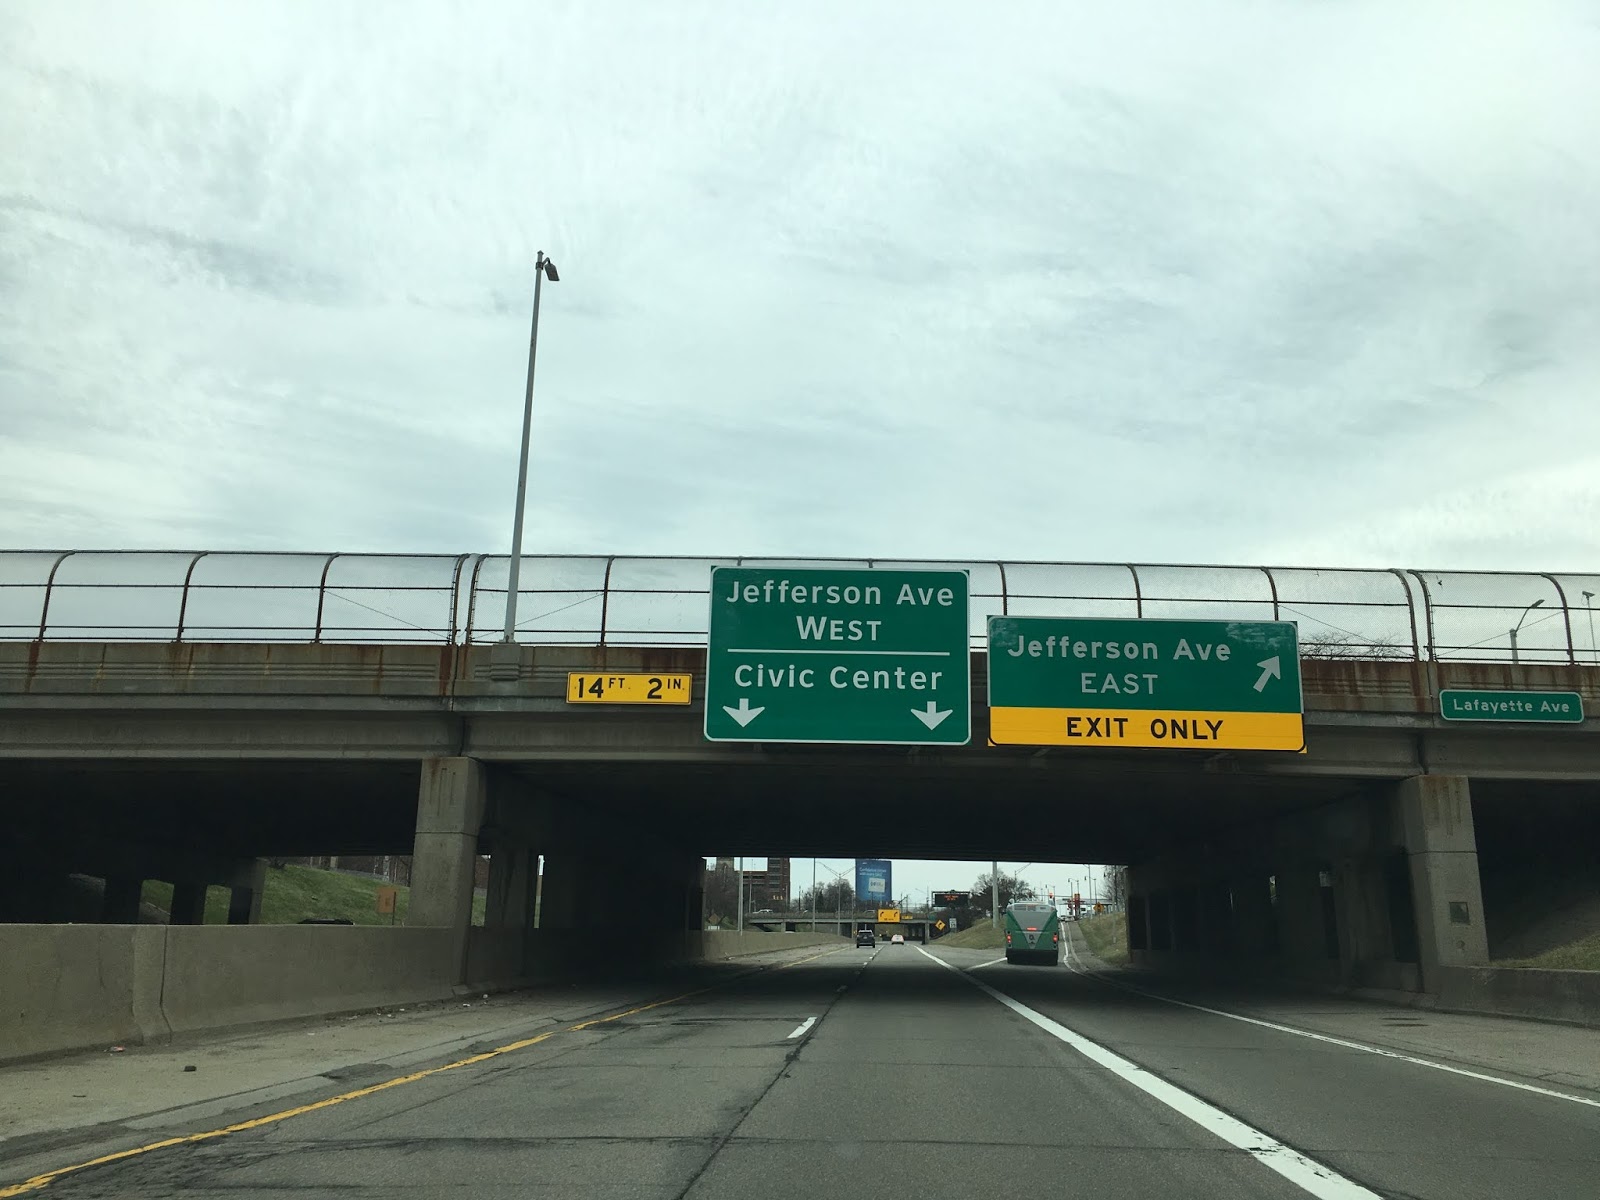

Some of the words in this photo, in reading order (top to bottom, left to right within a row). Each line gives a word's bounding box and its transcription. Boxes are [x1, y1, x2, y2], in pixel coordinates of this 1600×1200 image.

[726, 580, 882, 605] Jefferson
[896, 583, 954, 606] Ave
[796, 616, 882, 641] WEST
[1007, 635, 1158, 660] Jefferson
[1173, 638, 1231, 661] Ave
[734, 664, 815, 688] Civic
[830, 666, 943, 690] Center
[1081, 672, 1159, 695] EAST
[1453, 699, 1533, 714] Lafayette
[1540, 701, 1570, 713] Ave
[1066, 717, 1129, 738] EXIT
[1150, 718, 1224, 740] ONLY
